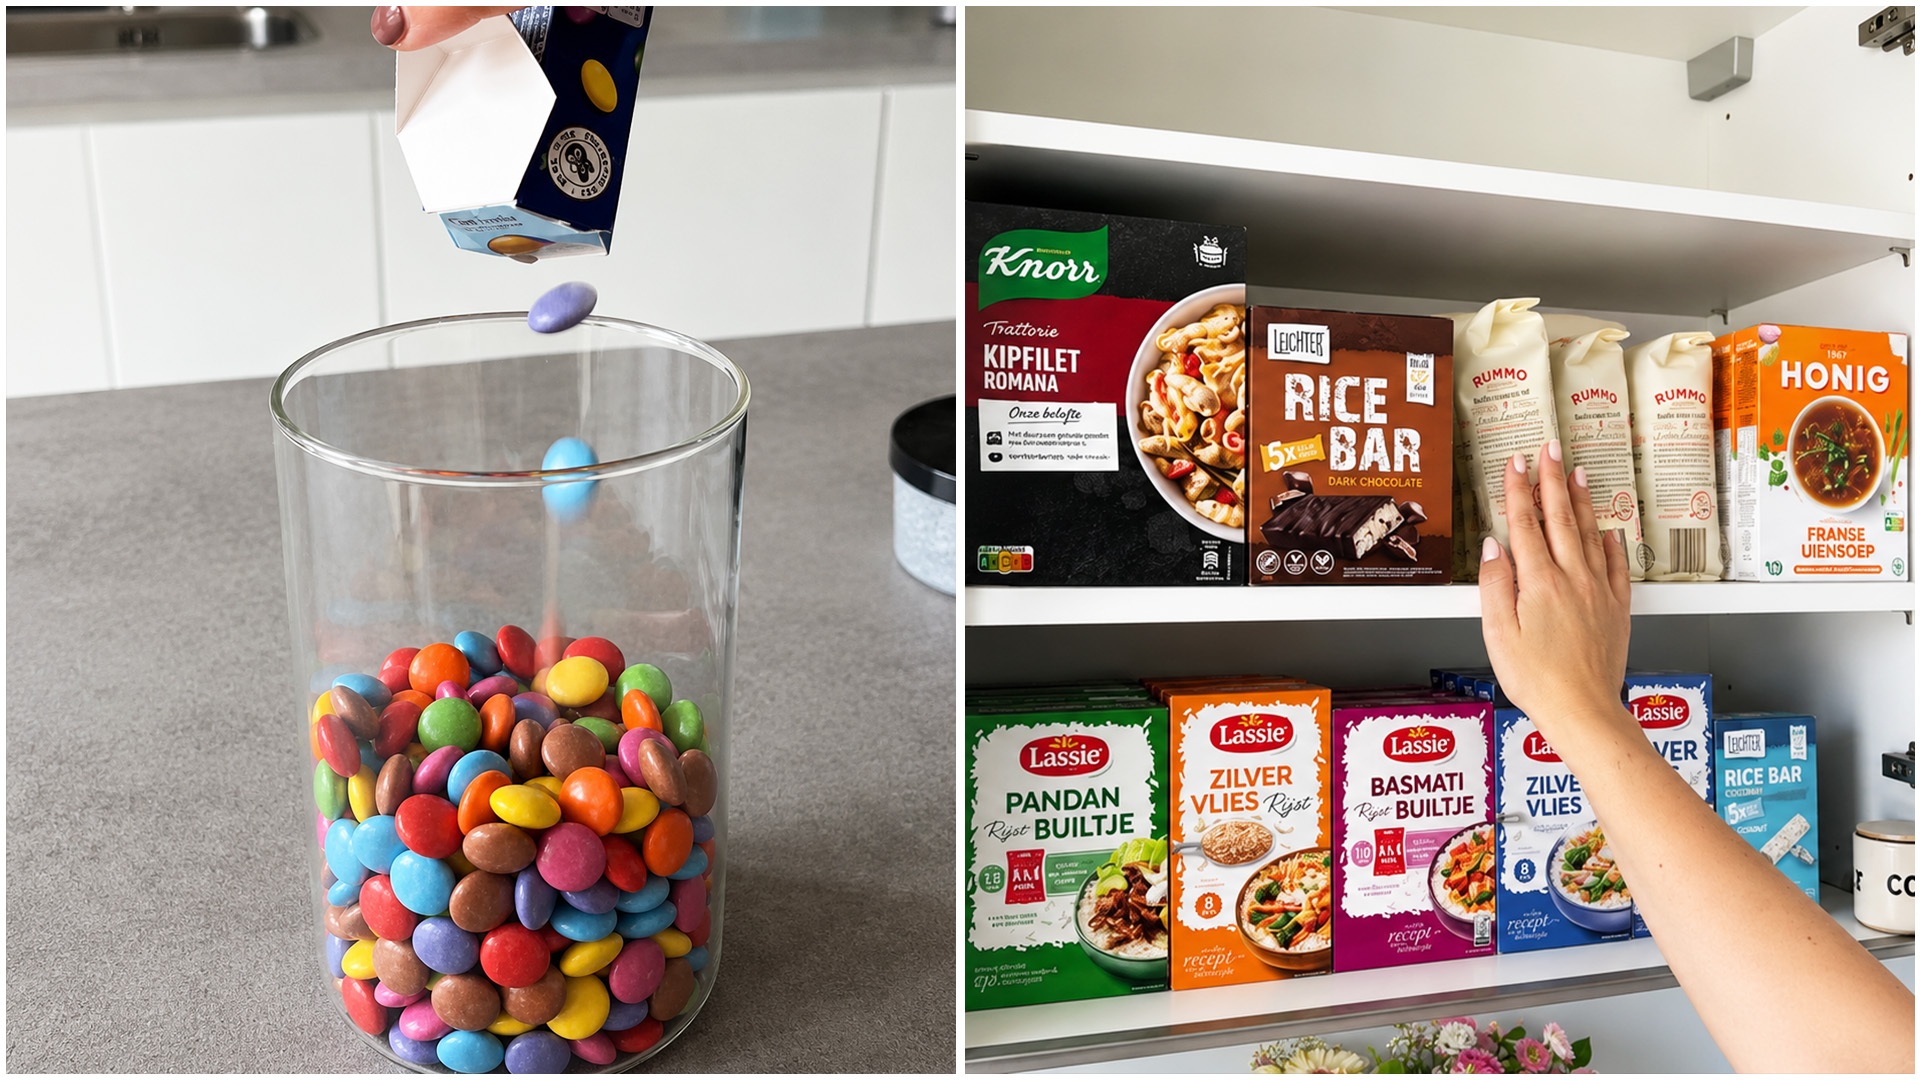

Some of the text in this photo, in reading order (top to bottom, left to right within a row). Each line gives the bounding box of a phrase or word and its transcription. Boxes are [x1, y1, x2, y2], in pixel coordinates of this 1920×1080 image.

[984, 246, 1100, 283] Knorr
[983, 321, 1059, 338] Trattorie
[1273, 329, 1325, 356] LEICHTER
[984, 344, 1080, 373] KIPFILET
[984, 371, 1059, 392] ROMANA
[1472, 368, 1527, 388] RUMMO
[1781, 360, 1890, 393] HONIG
[1285, 373, 1388, 424] RICE
[1571, 388, 1617, 405] RUMMO
[1654, 388, 1706, 405] RUMMO
[1009, 406, 1040, 419] Onze
[1268, 441, 1297, 471] 5x
[1330, 426, 1421, 472] BAR
[1328, 476, 1423, 488] DARK CHOCOLATE
[1807, 526, 1866, 542] FRANSE
[1802, 544, 1875, 559] UIENSOEP
[1632, 704, 1683, 722] Lassie
[1218, 725, 1286, 745] Lassie
[1390, 736, 1448, 756] Lassie
[1653, 740, 1698, 761] VER
[1029, 747, 1101, 769] Lassie
[1210, 765, 1292, 789] ZILVER
[1371, 772, 1464, 797] BASMATI
[1526, 774, 1581, 796] ZILVE
[1725, 767, 1764, 787] RICE
[1768, 765, 1802, 784] BAR
[1006, 786, 1120, 814] PANDAN
[1191, 791, 1312, 817] VLIES Rijst
[1396, 795, 1474, 819] BUILTJE
[1526, 796, 1582, 817] VLIES
[1727, 802, 1747, 825] 5x
[984, 813, 1135, 843] Rijst BUILTJE
[1520, 862, 1529, 875] 8
[1204, 896, 1214, 910] 8
[1183, 950, 1233, 970] recept
